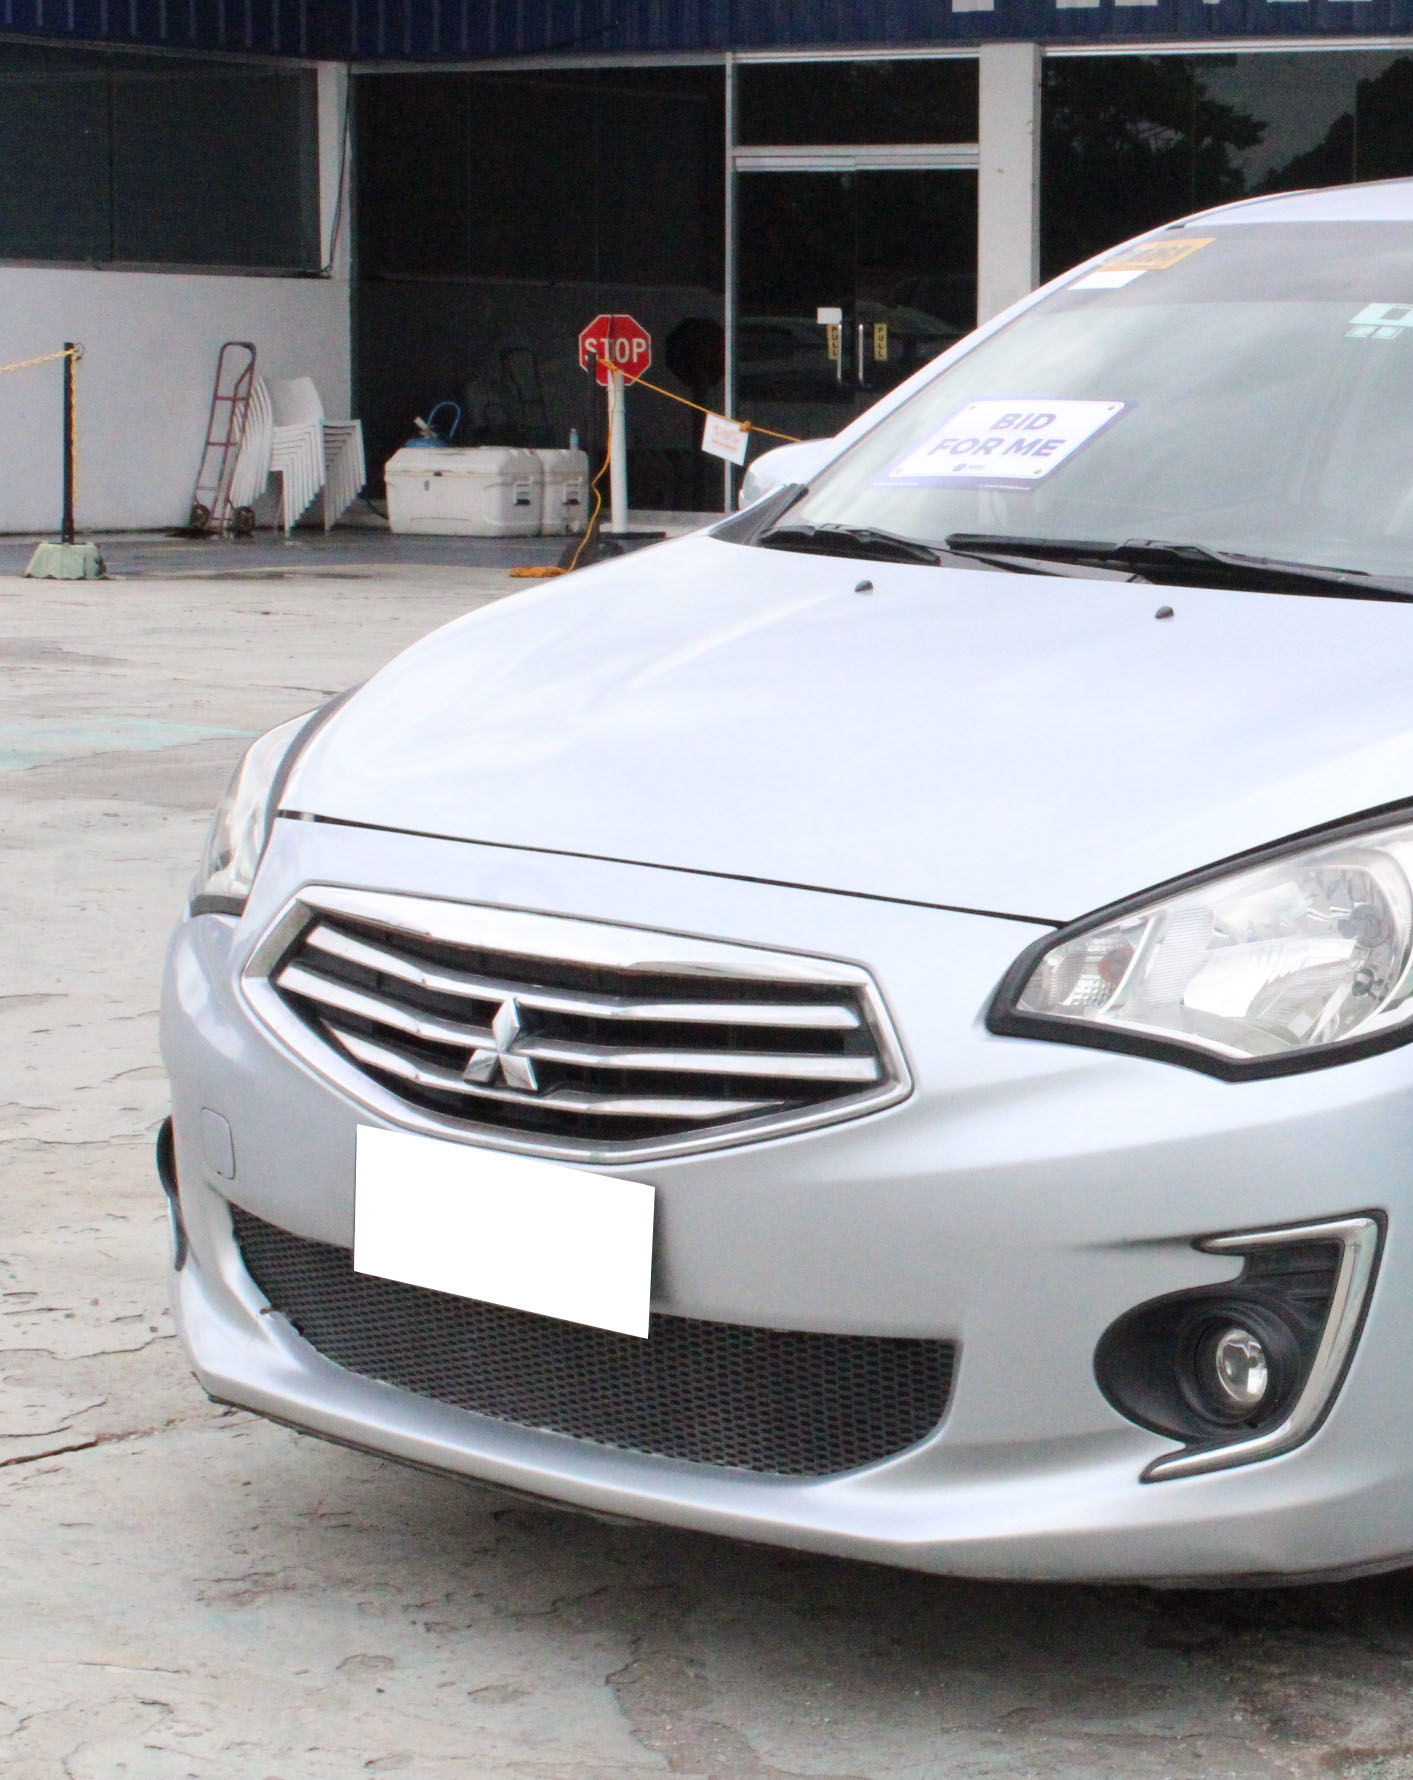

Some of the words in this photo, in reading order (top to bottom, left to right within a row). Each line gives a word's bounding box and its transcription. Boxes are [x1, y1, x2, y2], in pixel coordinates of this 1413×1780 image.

[585, 338, 647, 363] STOP
[990, 412, 1056, 431] BID
[928, 437, 1004, 456] FOR
[1002, 438, 1066, 457] ME
